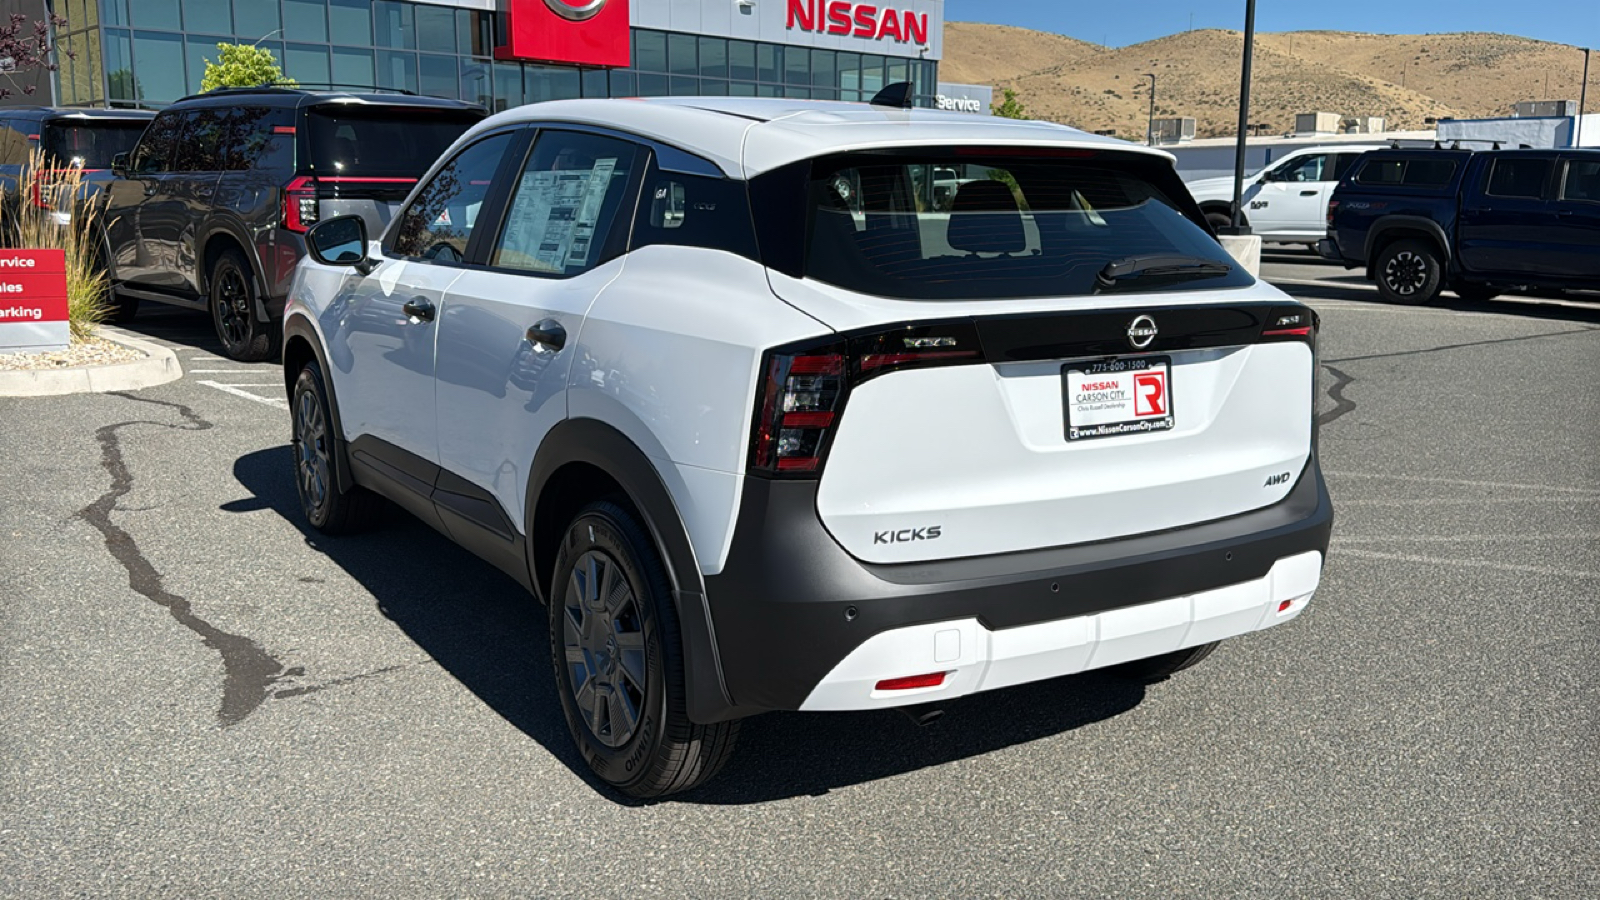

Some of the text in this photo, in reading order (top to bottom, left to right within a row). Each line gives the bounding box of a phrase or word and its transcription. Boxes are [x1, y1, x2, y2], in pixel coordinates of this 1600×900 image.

[786, 0, 928, 44] NISSAN
[936, 95, 980, 111] Service
[0, 256, 35, 267] rvice
[0, 282, 23, 293] les
[0, 306, 42, 319] arking
[1127, 328, 1158, 336] NISSAN
[1081, 381, 1119, 391] NISSAN
[1076, 390, 1125, 403] CARSON CITY
[1263, 471, 1290, 488] AWD
[873, 525, 942, 544] KICKS
